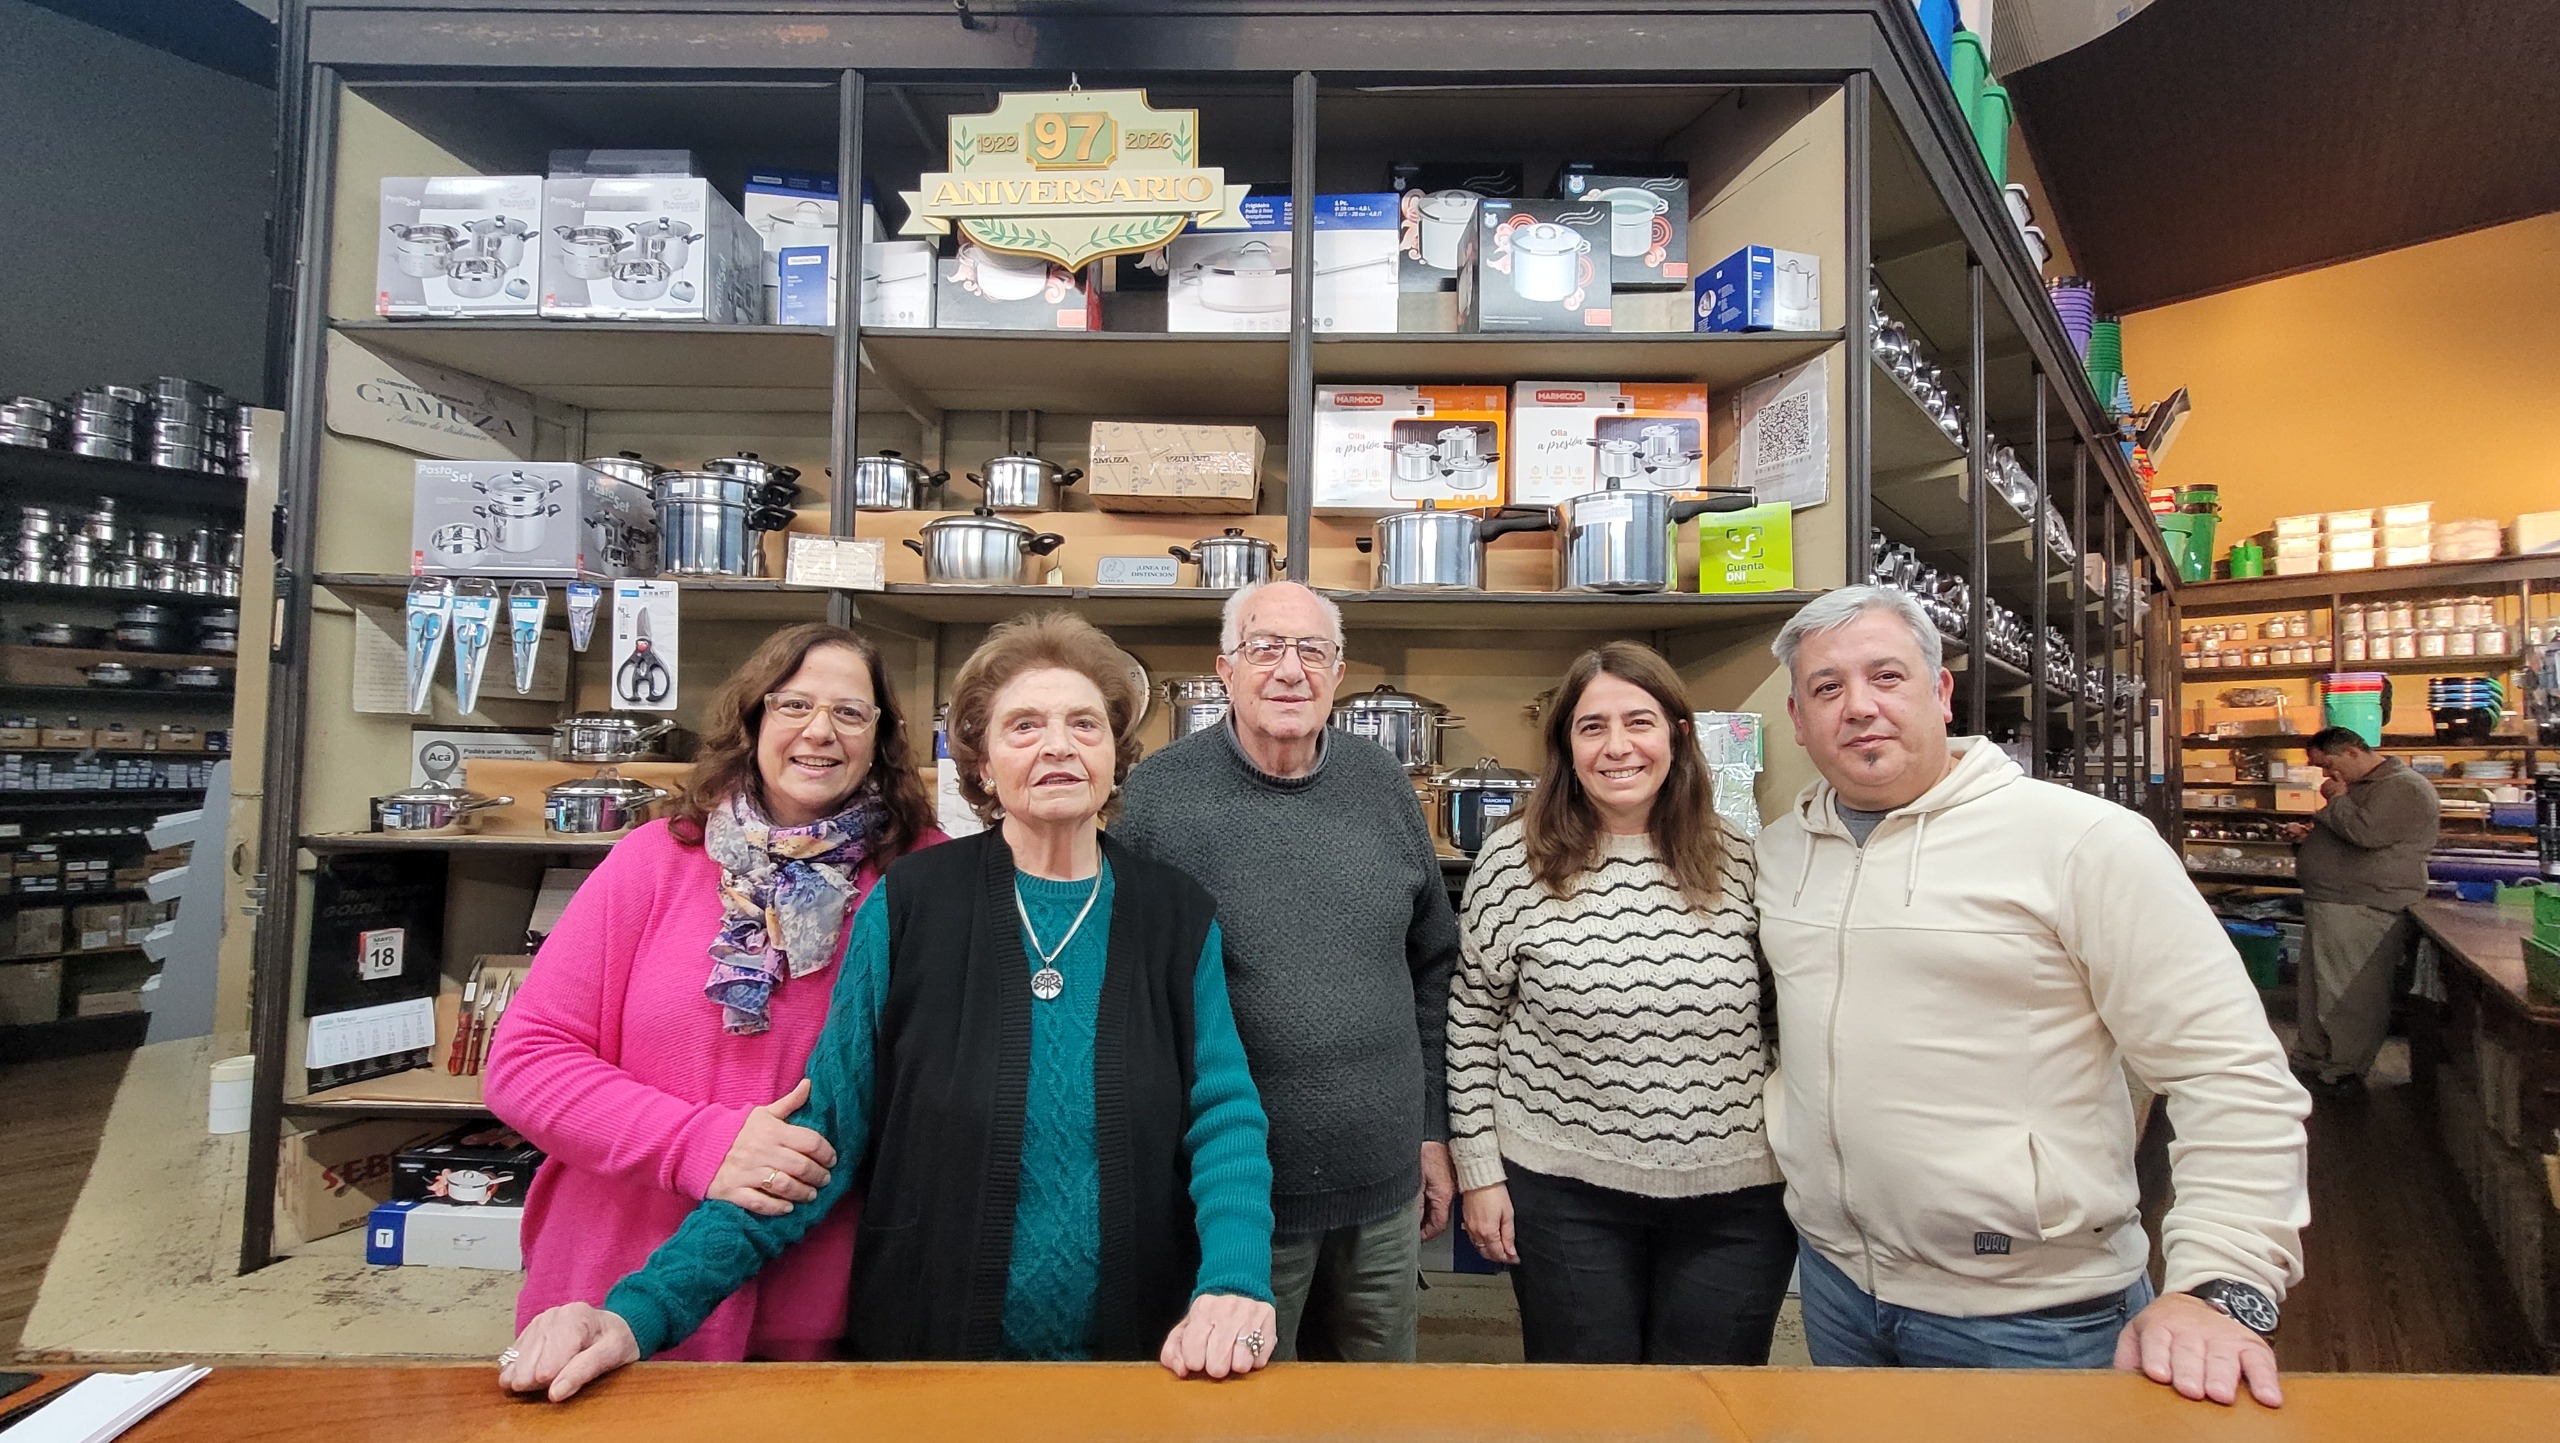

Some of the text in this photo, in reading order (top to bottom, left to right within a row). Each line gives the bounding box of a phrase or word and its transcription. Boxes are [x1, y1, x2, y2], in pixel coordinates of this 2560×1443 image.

[1034, 112, 1105, 161] 97
[1125, 131, 1173, 150] 2026
[976, 134, 1018, 154] 1929
[929, 174, 1214, 207] ANIVERSARIO
[571, 200, 585, 209] Set
[1336, 395, 1382, 404] MARMICOC
[1538, 392, 1583, 401] MARMICOC
[356, 383, 517, 437] GAMUZA
[1348, 432, 1365, 440] Olla
[1550, 429, 1568, 437] Olla
[1344, 440, 1380, 458] presión
[1547, 436, 1583, 455] presión
[418, 464, 452, 476] Pasta
[450, 470, 474, 483] Set
[587, 477, 615, 499] Pasta
[613, 496, 631, 514] Set
[1726, 562, 1765, 572] Cuenta
[1726, 571, 1746, 582] DNI
[427, 751, 451, 762] Acá
[512, 748, 536, 756] tarjeta
[373, 935, 394, 943] MAYO
[370, 947, 395, 968] 18
[380, 1232, 390, 1245] T
